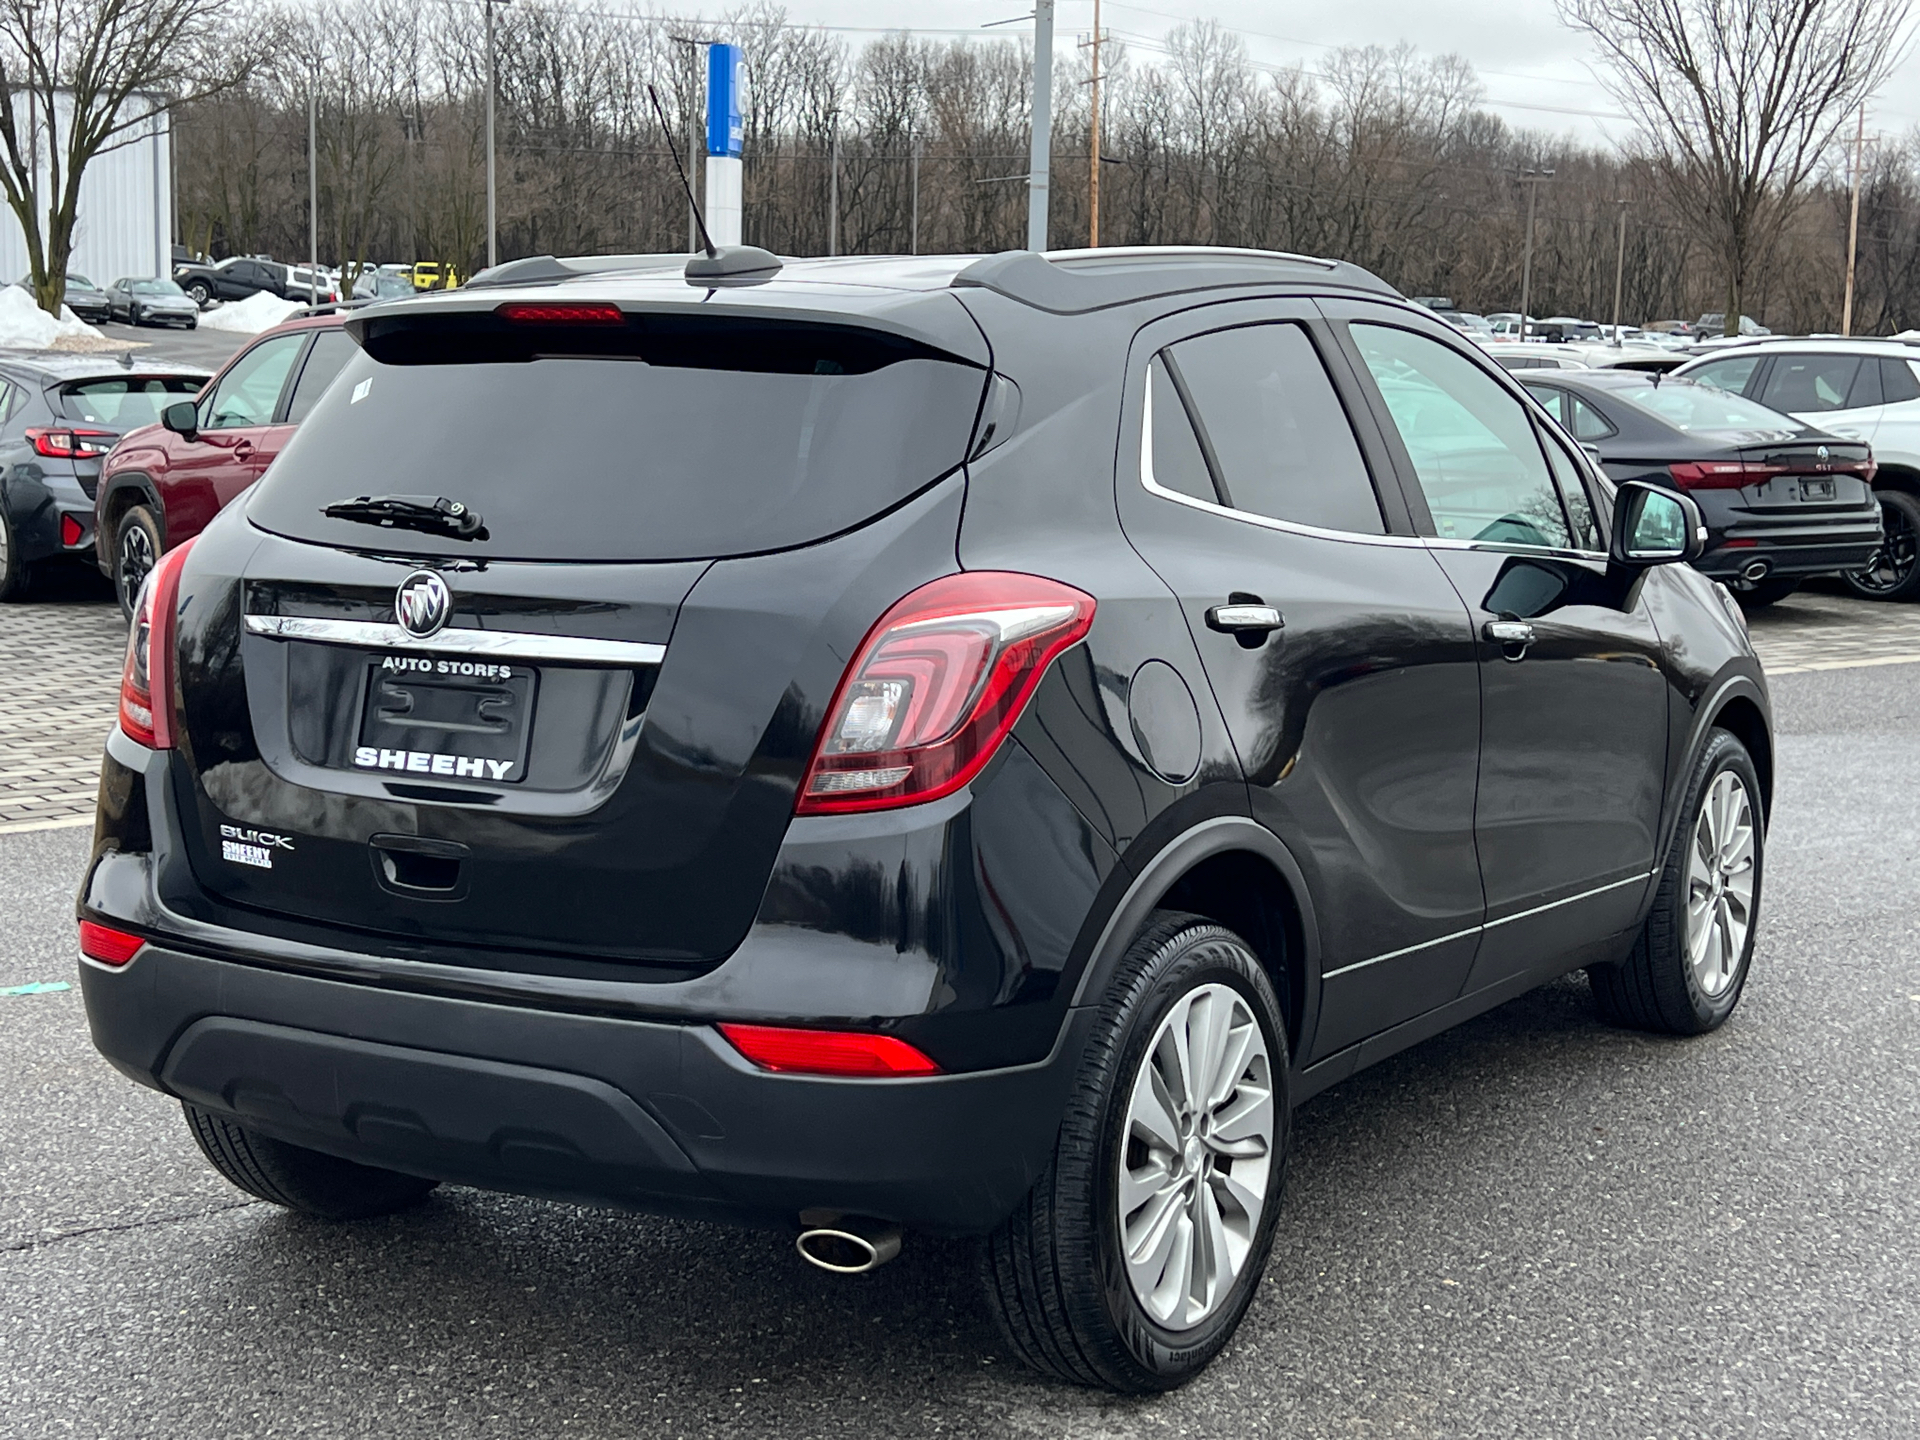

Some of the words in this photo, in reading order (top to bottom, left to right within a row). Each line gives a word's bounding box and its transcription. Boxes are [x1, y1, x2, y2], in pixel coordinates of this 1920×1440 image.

[382, 656, 432, 673] AUTO
[354, 747, 514, 780] SHEEHY
[220, 824, 295, 850] BUICK
[222, 840, 271, 861] SHEEHY
